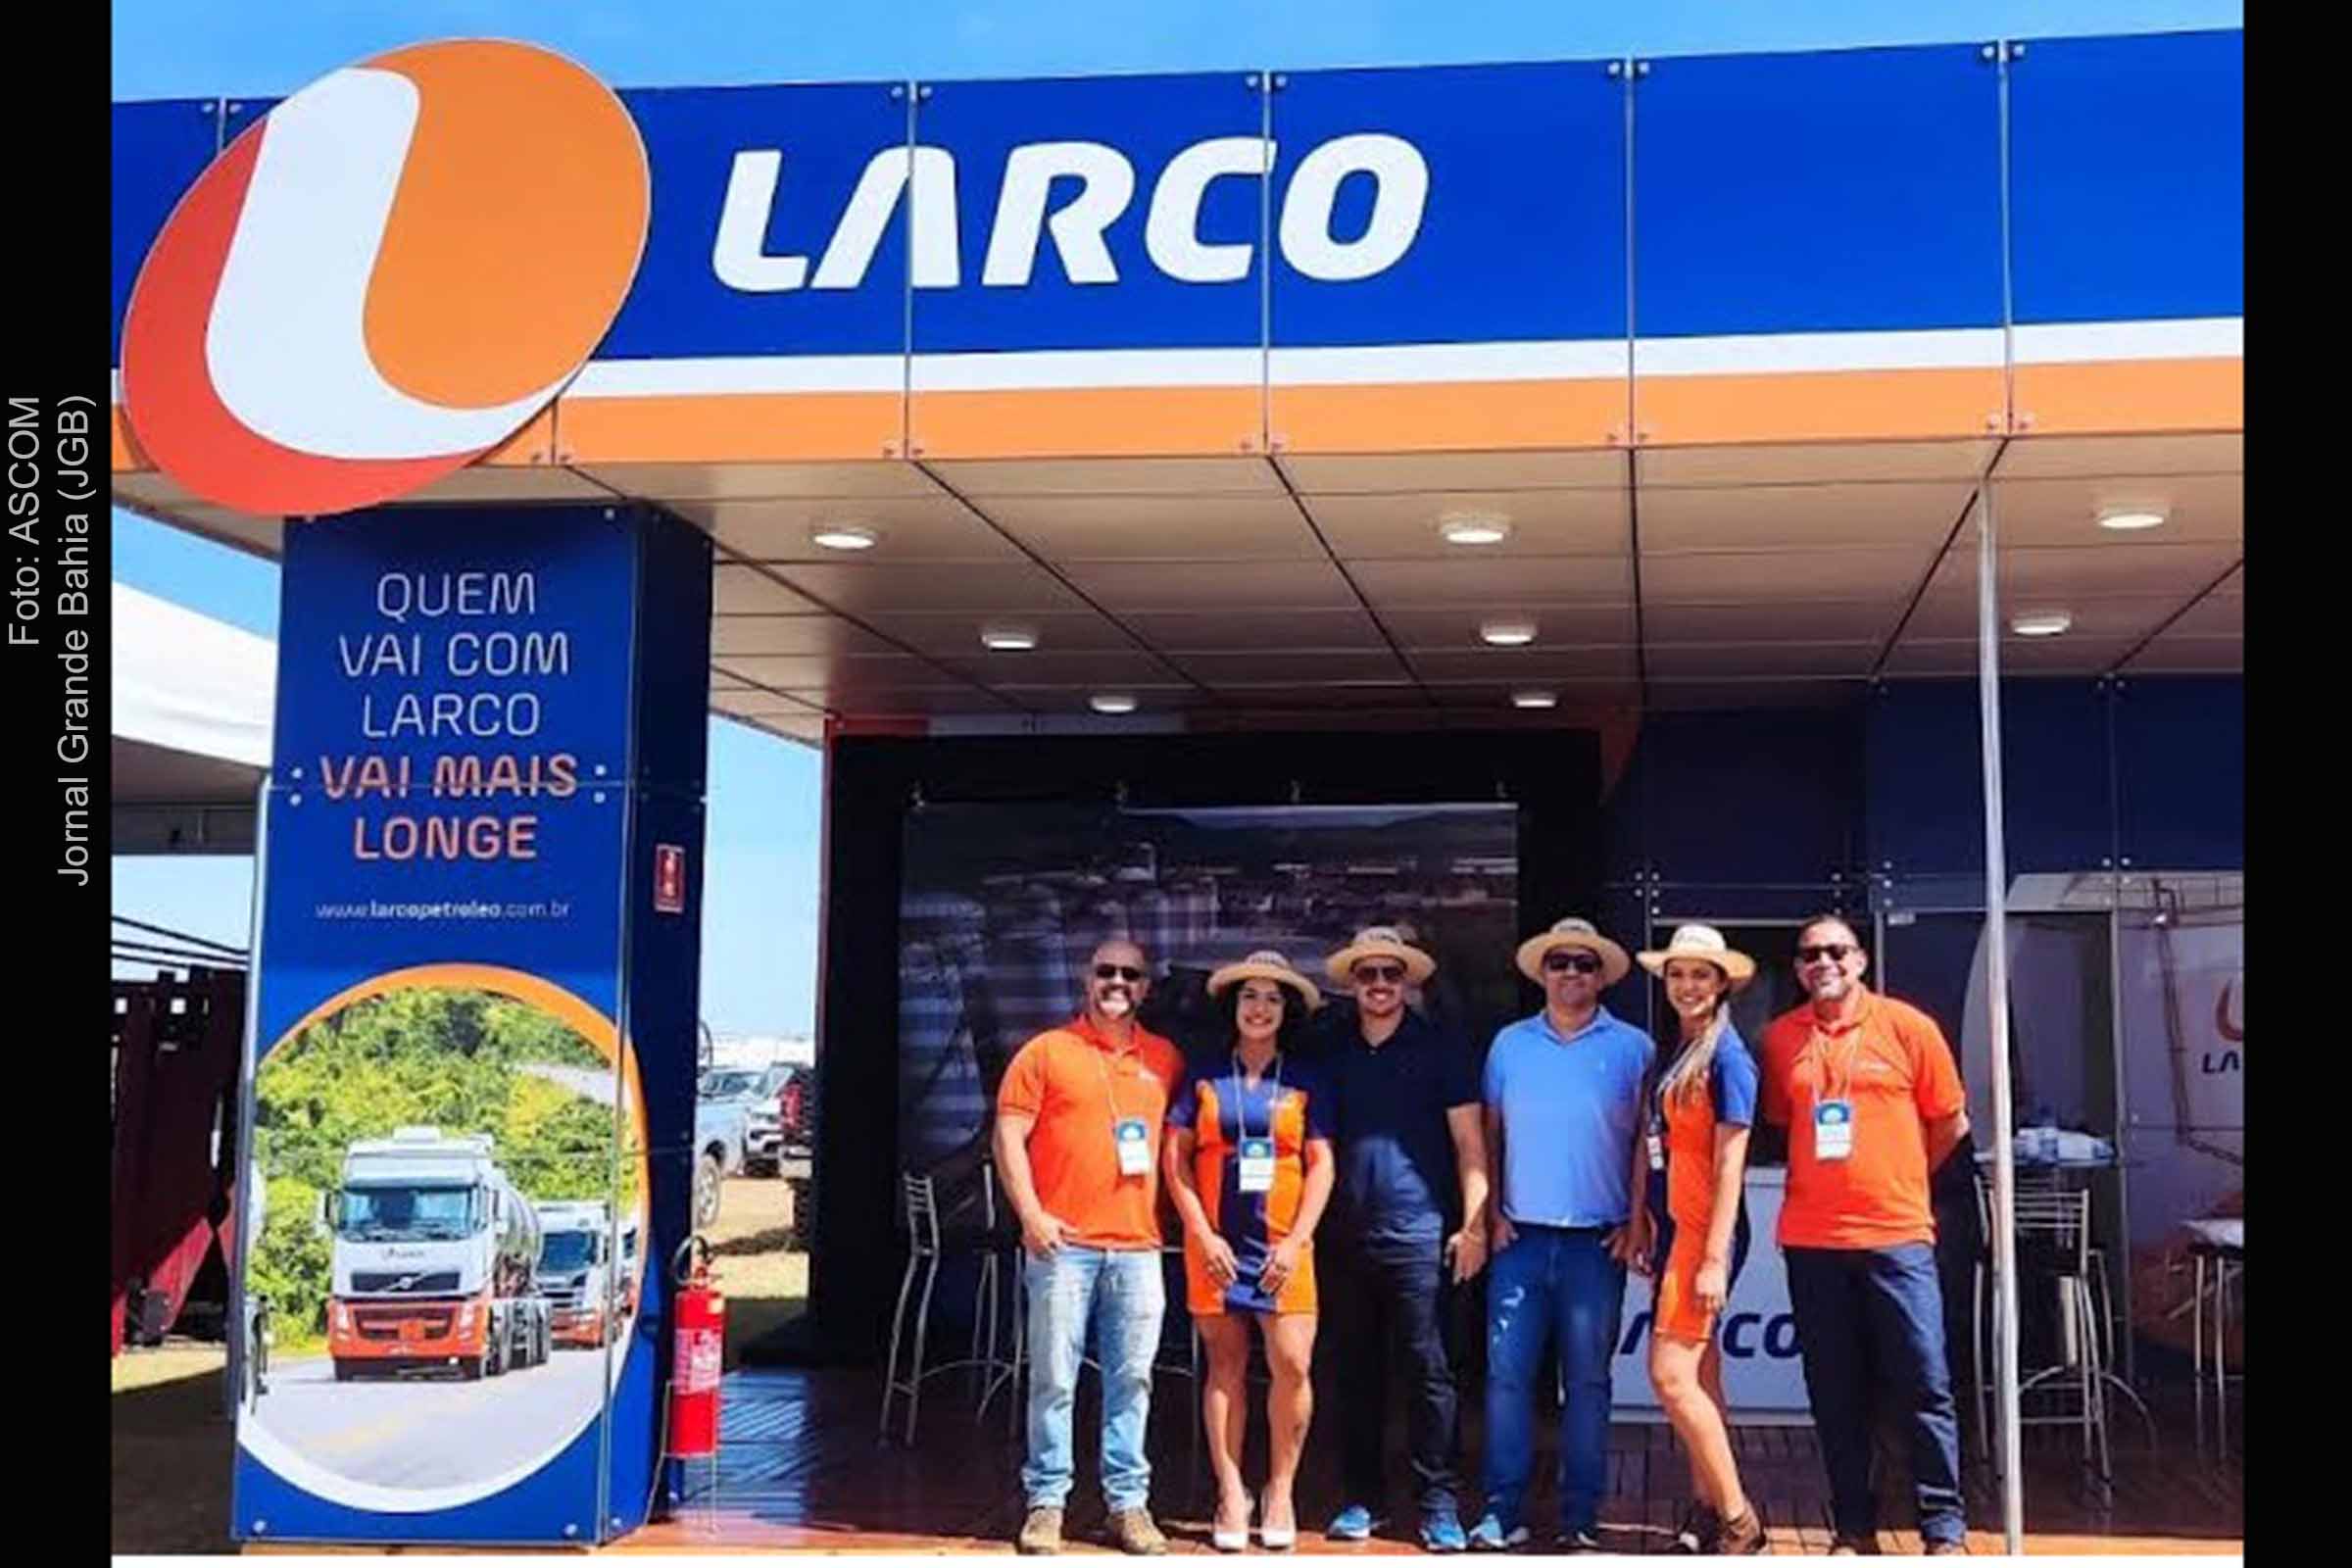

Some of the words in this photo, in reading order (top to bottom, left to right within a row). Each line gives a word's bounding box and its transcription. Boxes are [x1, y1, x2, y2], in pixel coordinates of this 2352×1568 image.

[712, 133, 1429, 292] LARCO
[377, 572, 535, 622] QUEM
[339, 634, 421, 676] VAI
[448, 632, 569, 676] COM
[363, 693, 540, 737] LARCO
[319, 756, 410, 799] VAI
[433, 754, 578, 798] MAIS
[354, 815, 538, 860] LONGE
[315, 899, 570, 921] www.larcopetroleo.com.br
